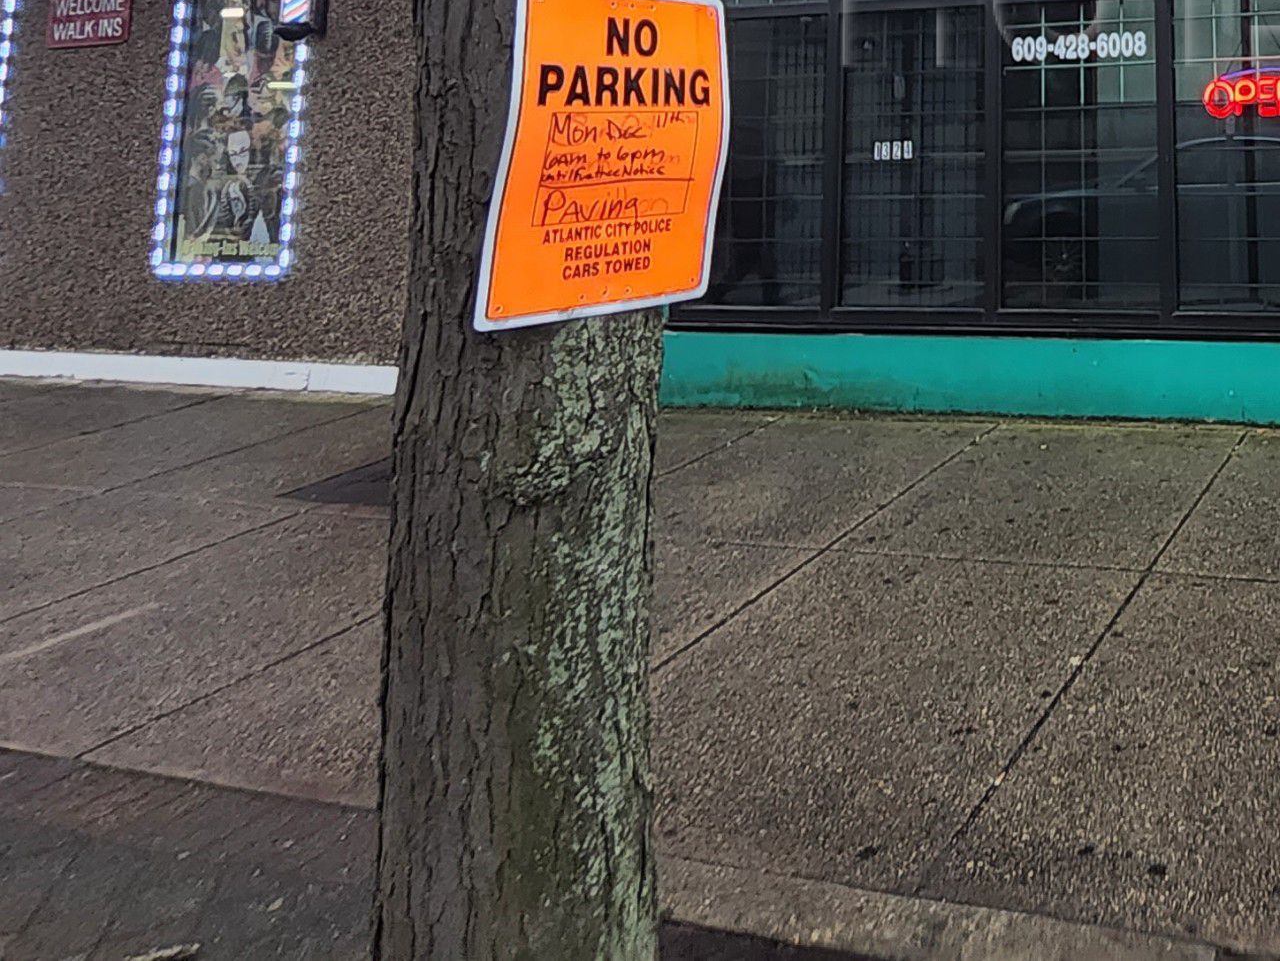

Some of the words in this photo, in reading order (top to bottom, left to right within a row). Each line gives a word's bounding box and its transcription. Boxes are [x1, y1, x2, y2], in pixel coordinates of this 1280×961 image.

[606, 17, 658, 57] NO
[1012, 31, 1146, 62] 609-428-6008
[537, 64, 710, 107] PARKING
[875, 141, 912, 160] 1324
[543, 225, 602, 244] ATLANTIC
[605, 222, 631, 238] CITY
[634, 219, 671, 236] POLICE
[564, 239, 651, 262] REGULATION
[562, 261, 600, 280] CARS
[605, 256, 651, 274] TOWED
